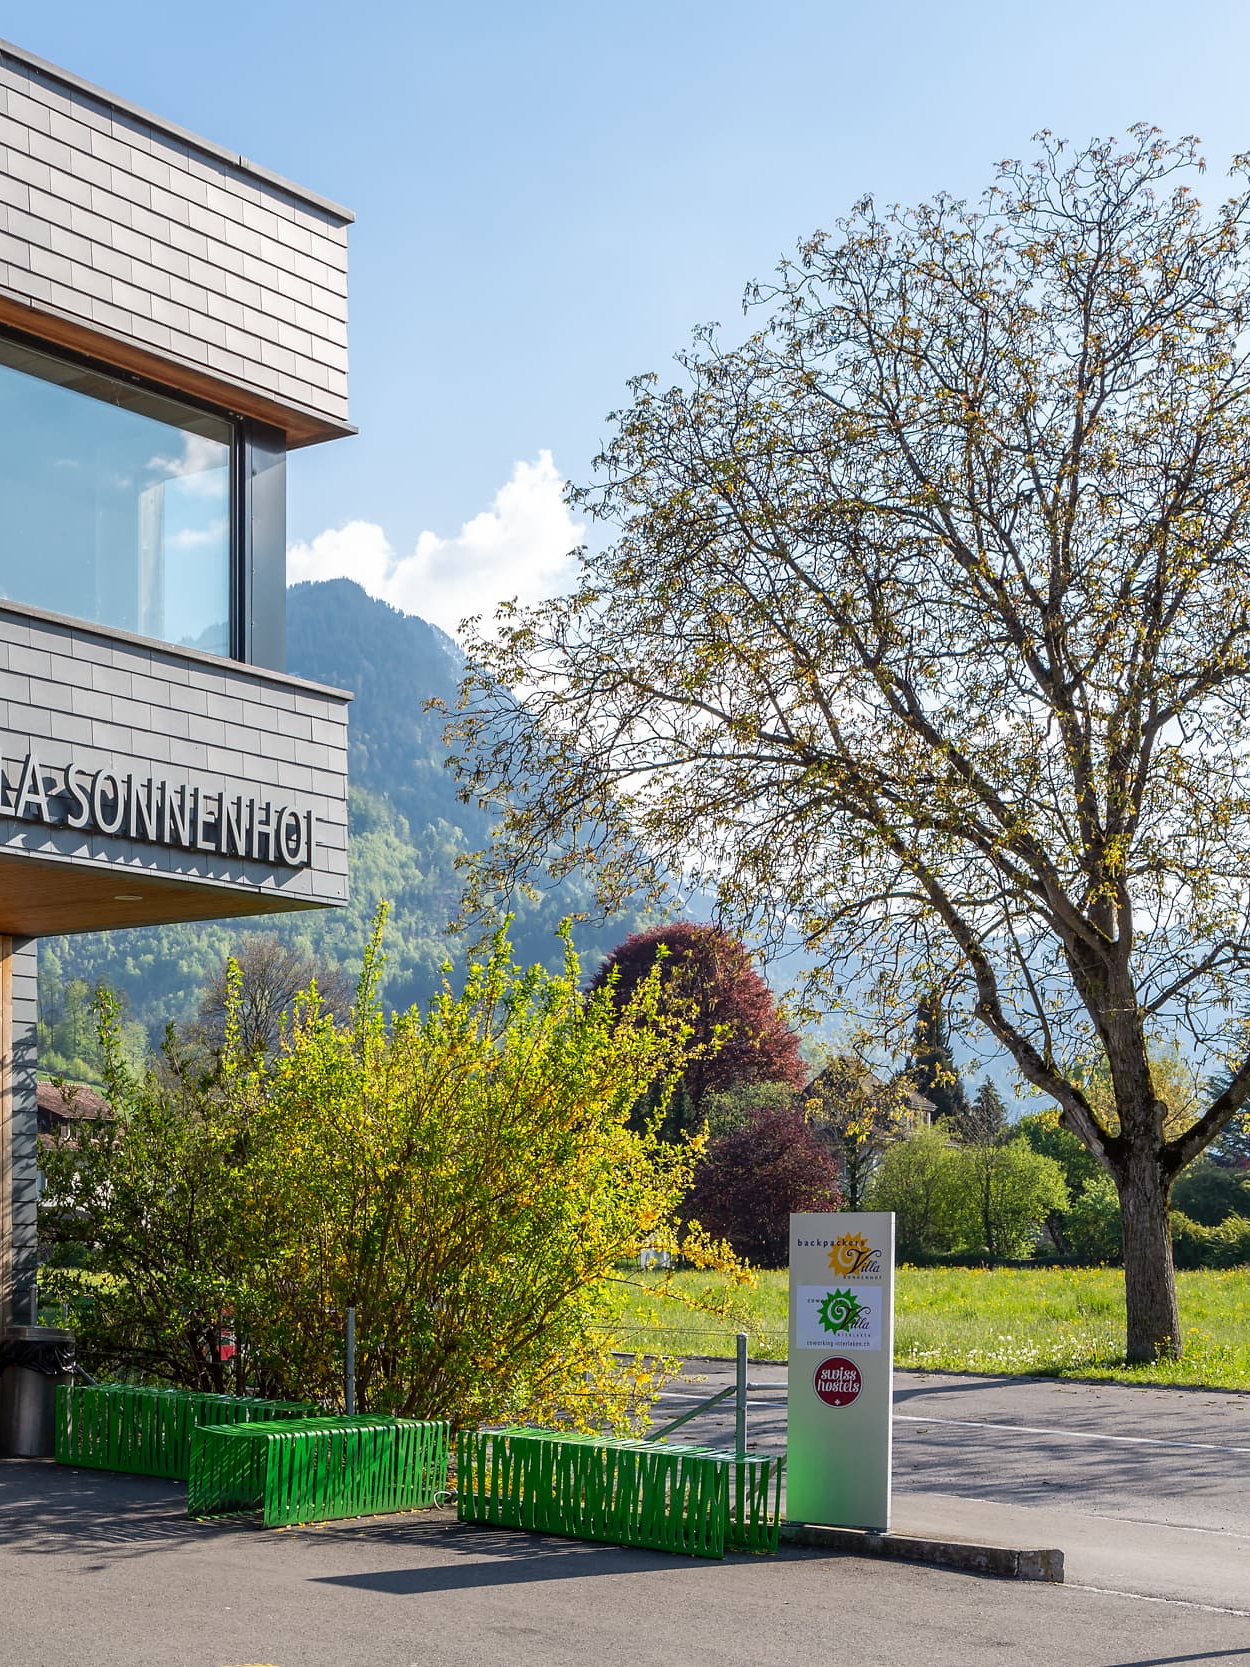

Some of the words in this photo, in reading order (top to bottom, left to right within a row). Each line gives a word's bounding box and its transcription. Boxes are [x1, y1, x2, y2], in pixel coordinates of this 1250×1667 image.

[797, 1238, 865, 1248] backpackers
[845, 1248, 882, 1275] Villa
[836, 1304, 872, 1331] Villa
[820, 1366, 857, 1381] swiss
[817, 1377, 860, 1393] hostels
